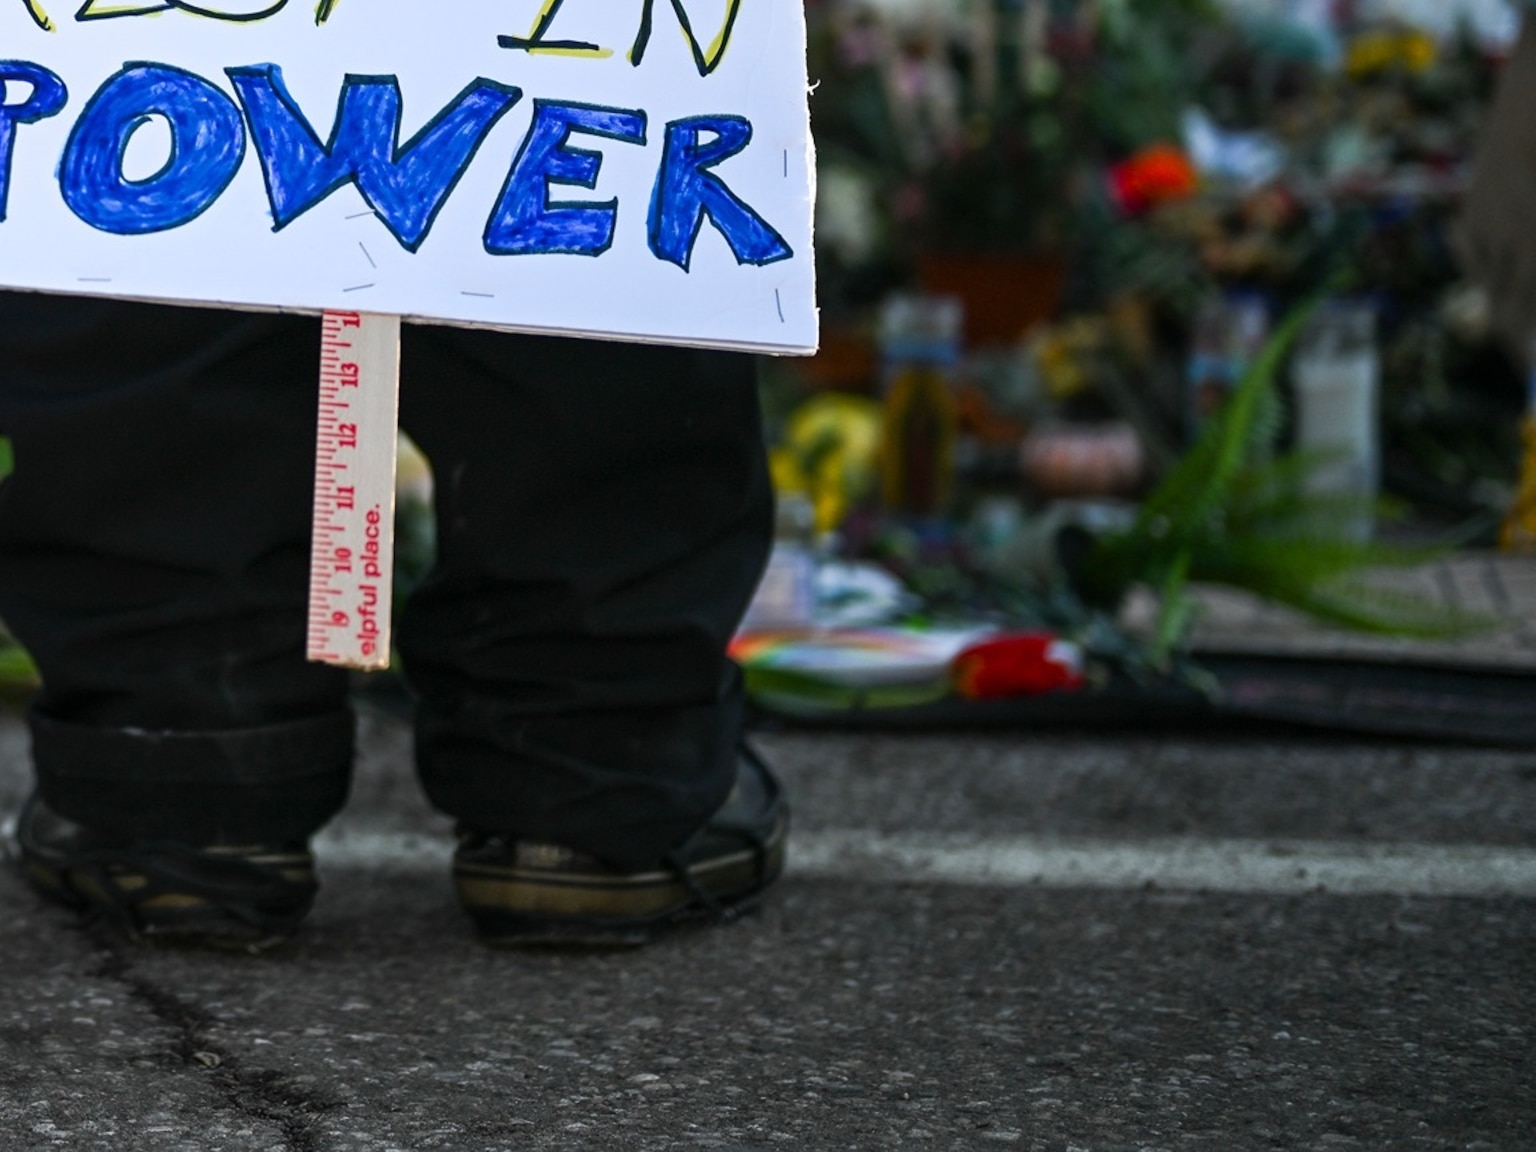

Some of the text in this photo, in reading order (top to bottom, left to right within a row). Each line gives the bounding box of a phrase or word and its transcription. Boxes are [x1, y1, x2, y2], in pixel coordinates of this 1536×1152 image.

[340, 363, 359, 388] 13
[338, 423, 357, 448] 12
[336, 485, 355, 511] 11
[360, 503, 381, 578] place.
[334, 547, 352, 574] 10
